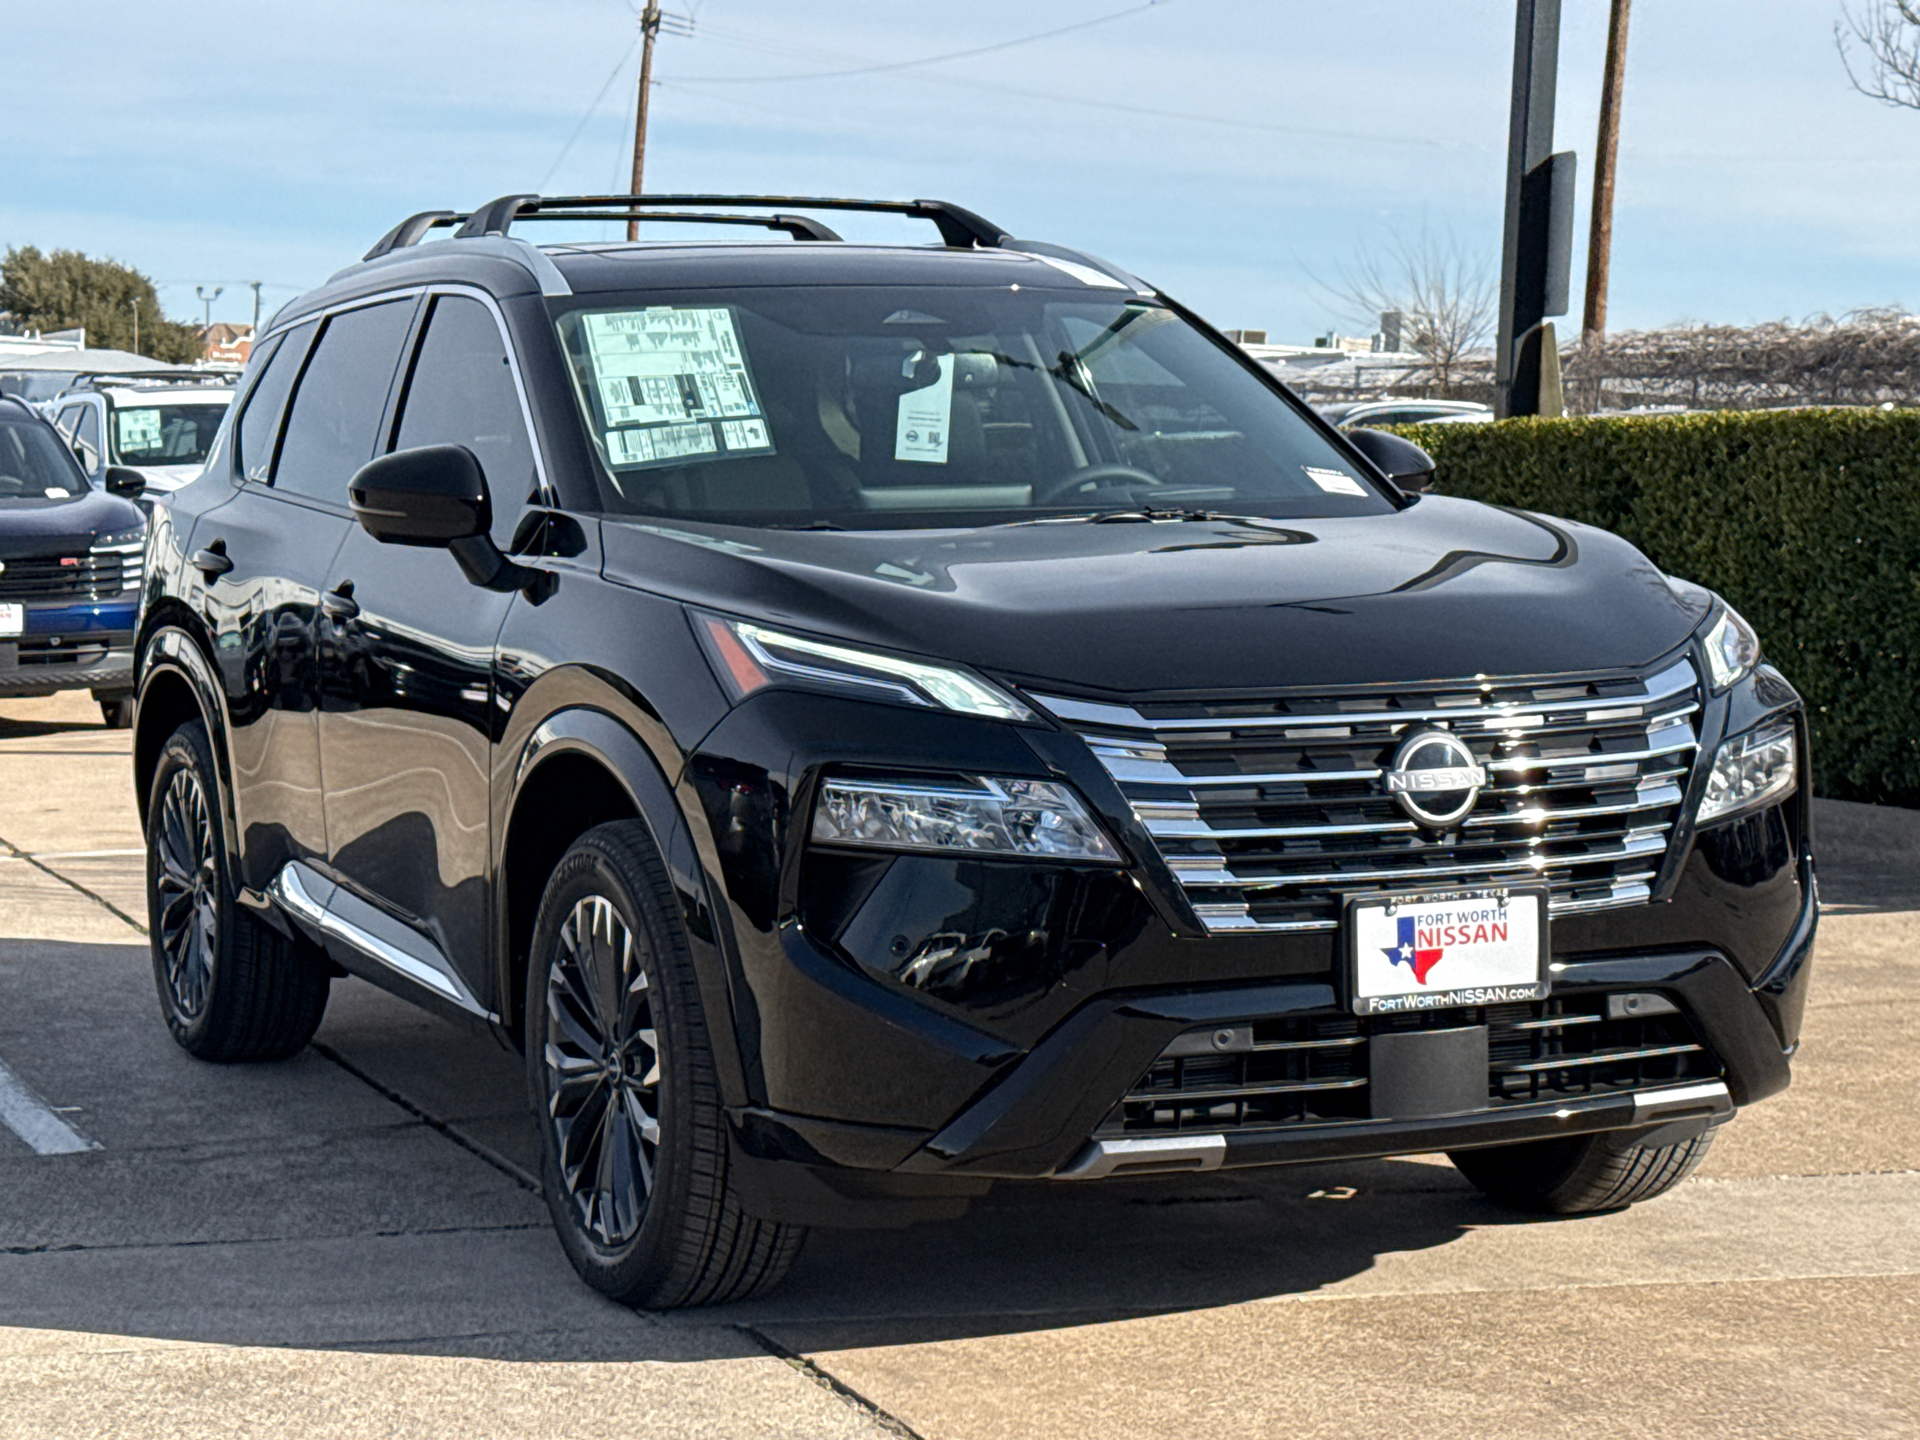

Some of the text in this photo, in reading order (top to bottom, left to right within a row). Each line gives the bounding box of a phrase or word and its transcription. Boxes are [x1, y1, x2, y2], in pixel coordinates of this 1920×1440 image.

[1388, 771, 1484, 790] NISSAN
[1390, 888, 1509, 905] FORT WORTH TEXAS
[1417, 908, 1507, 926] FORT WORTH
[1417, 922, 1507, 948] NISSAN
